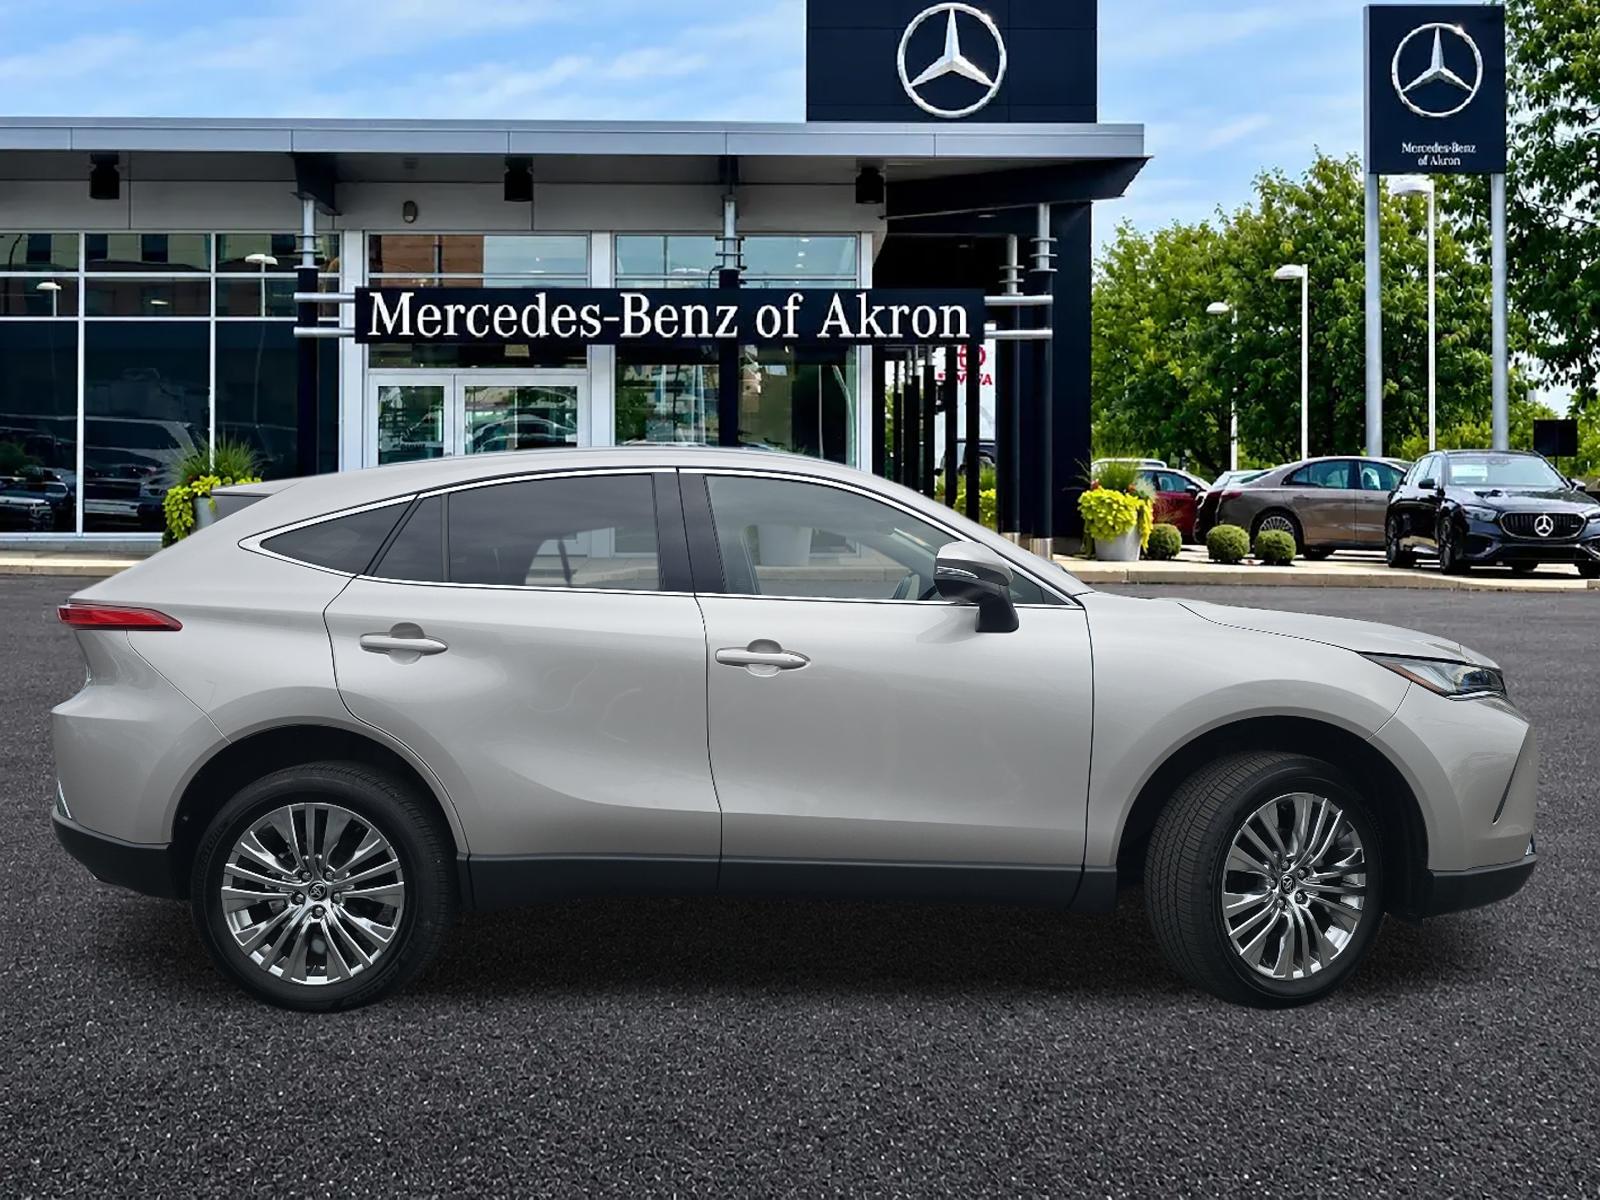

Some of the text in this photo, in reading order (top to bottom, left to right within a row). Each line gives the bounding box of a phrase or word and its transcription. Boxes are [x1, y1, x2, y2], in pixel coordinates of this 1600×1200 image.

[1401, 142, 1477, 153] Mercedes-Benz
[1417, 154, 1461, 166] of Akron
[367, 291, 970, 338] Mercedes-Benz of Akron
